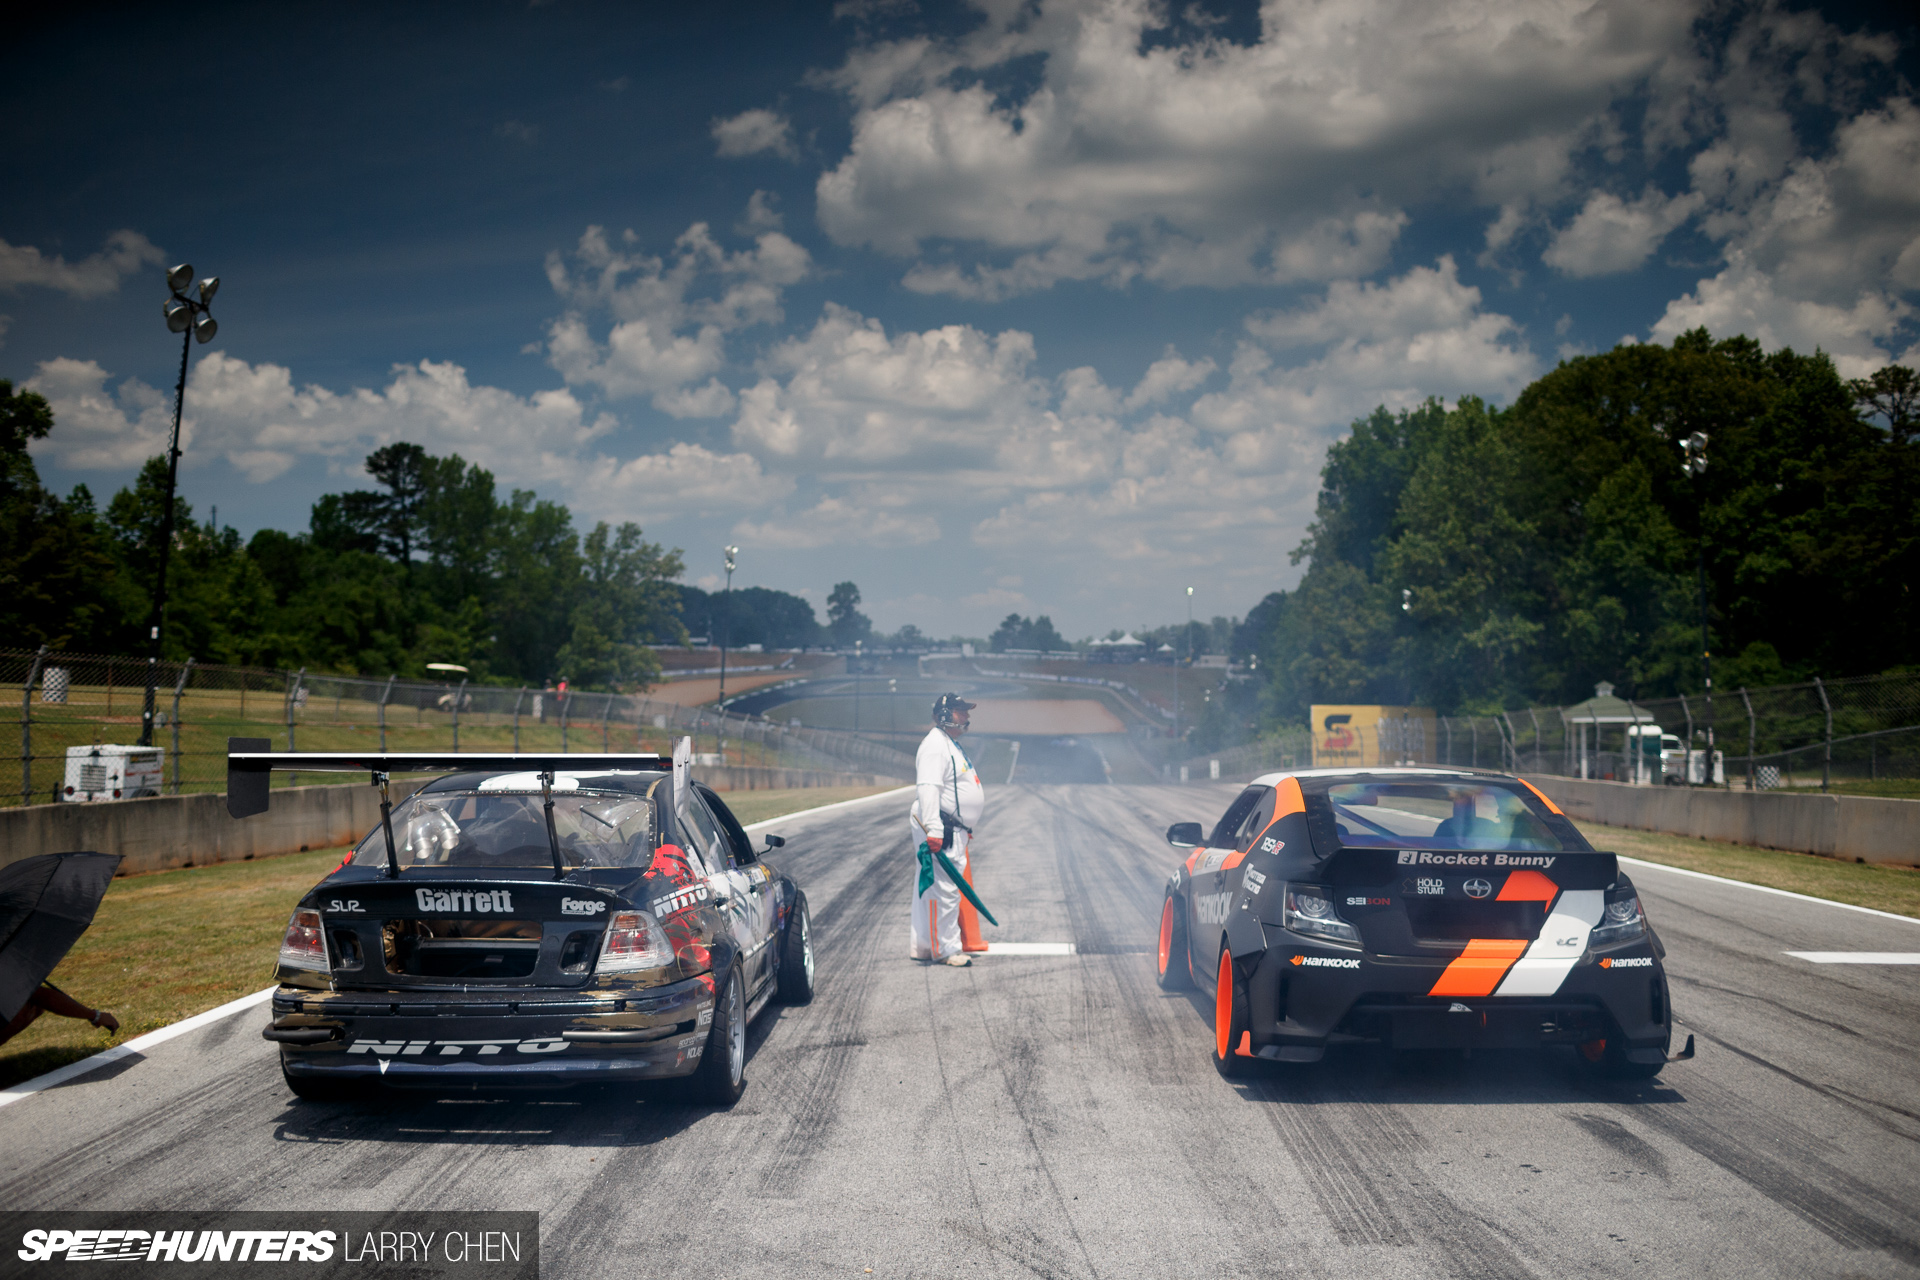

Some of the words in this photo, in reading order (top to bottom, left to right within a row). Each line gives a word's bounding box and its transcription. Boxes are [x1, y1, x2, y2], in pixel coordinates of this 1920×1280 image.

[1418, 852, 1488, 866] Rocket
[1494, 853, 1556, 868] Bunny
[1417, 878, 1443, 888] HOLD
[1417, 886, 1445, 895] STUMT
[326, 899, 367, 912] SLR
[414, 888, 515, 913] Garrett
[653, 883, 708, 919] NITTO
[1346, 897, 1391, 906] SEIBON
[697, 1007, 714, 1027] NOS
[346, 1037, 571, 1055] NITTO
